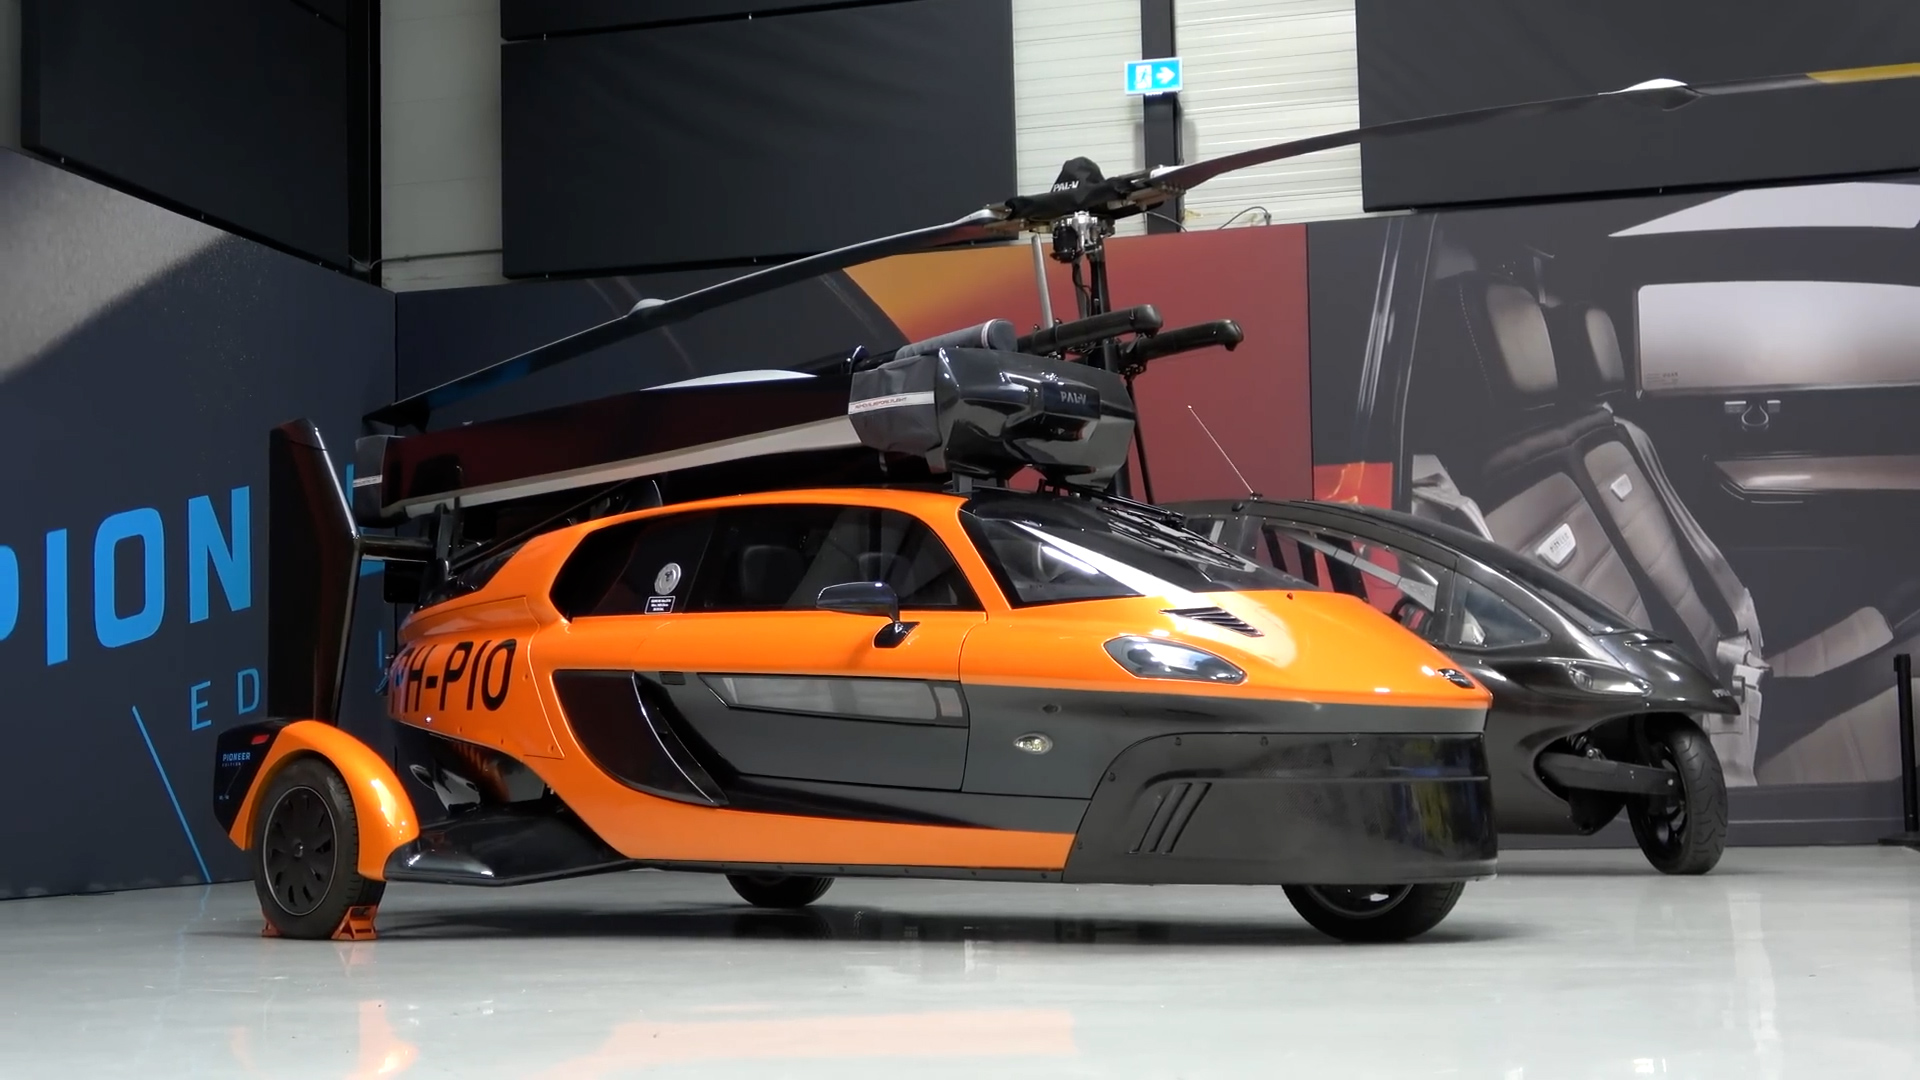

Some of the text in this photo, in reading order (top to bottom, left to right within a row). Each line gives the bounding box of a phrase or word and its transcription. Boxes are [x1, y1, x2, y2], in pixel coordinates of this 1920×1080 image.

[1053, 181, 1079, 192] PAL-V
[1060, 391, 1086, 404] PAL-V
[191, 668, 260, 730] ED
[222, 752, 251, 762] PIONEER
